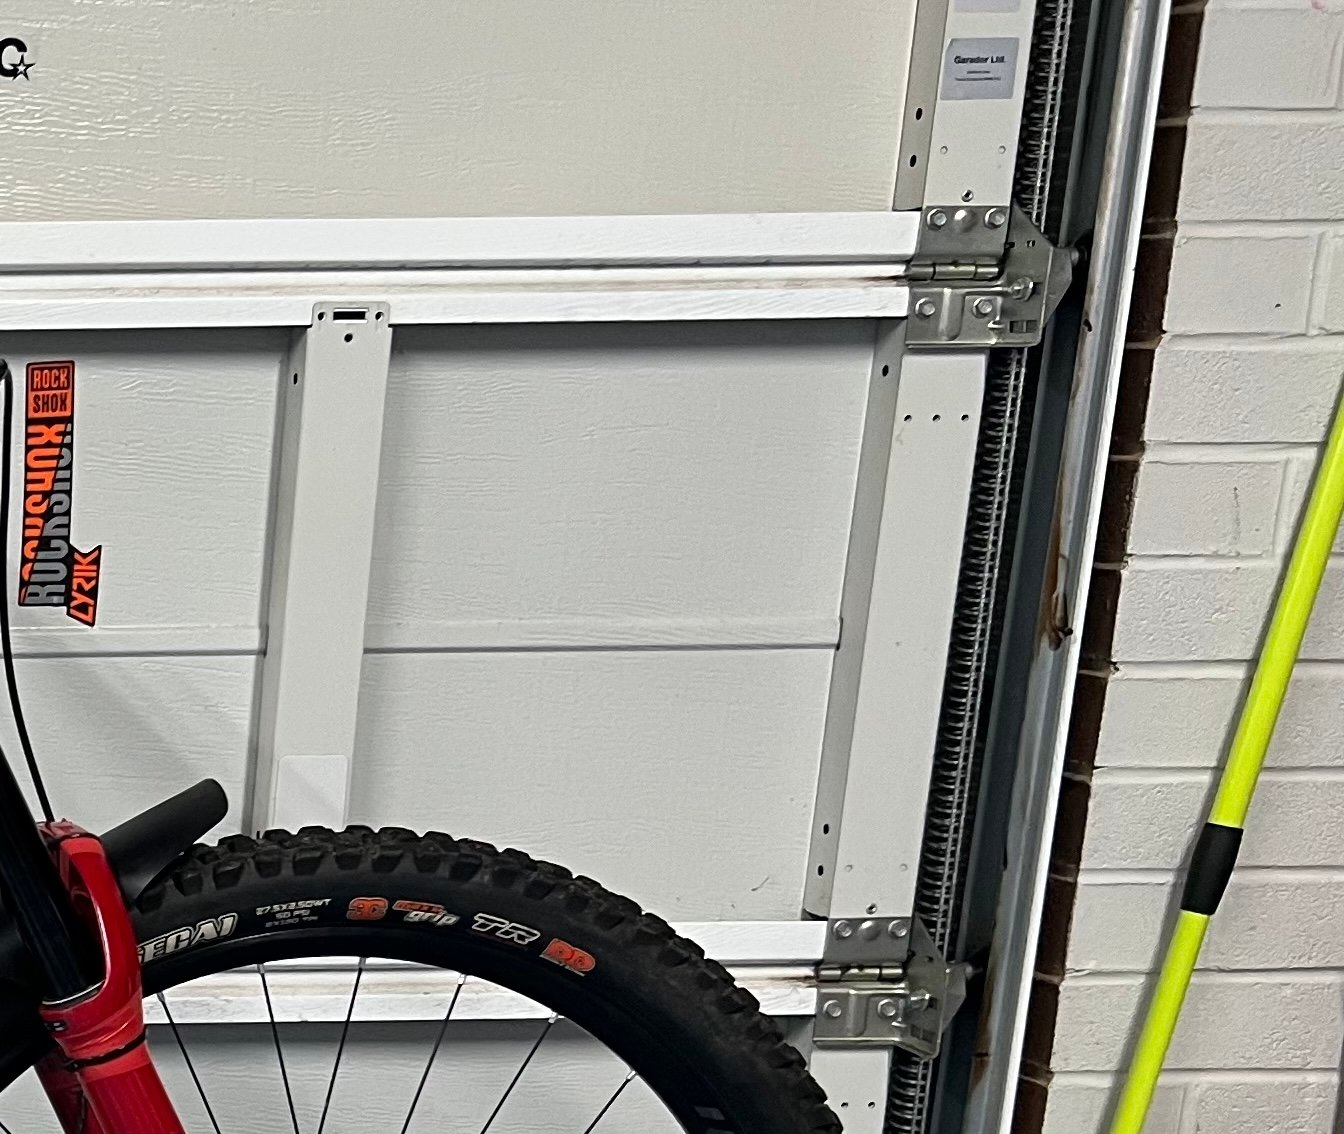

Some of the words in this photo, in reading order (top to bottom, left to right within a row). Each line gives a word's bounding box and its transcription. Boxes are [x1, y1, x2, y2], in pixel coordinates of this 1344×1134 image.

[32, 368, 68, 389] ROCK
[32, 392, 68, 414] SHOX
[472, 913, 540, 944] TR
